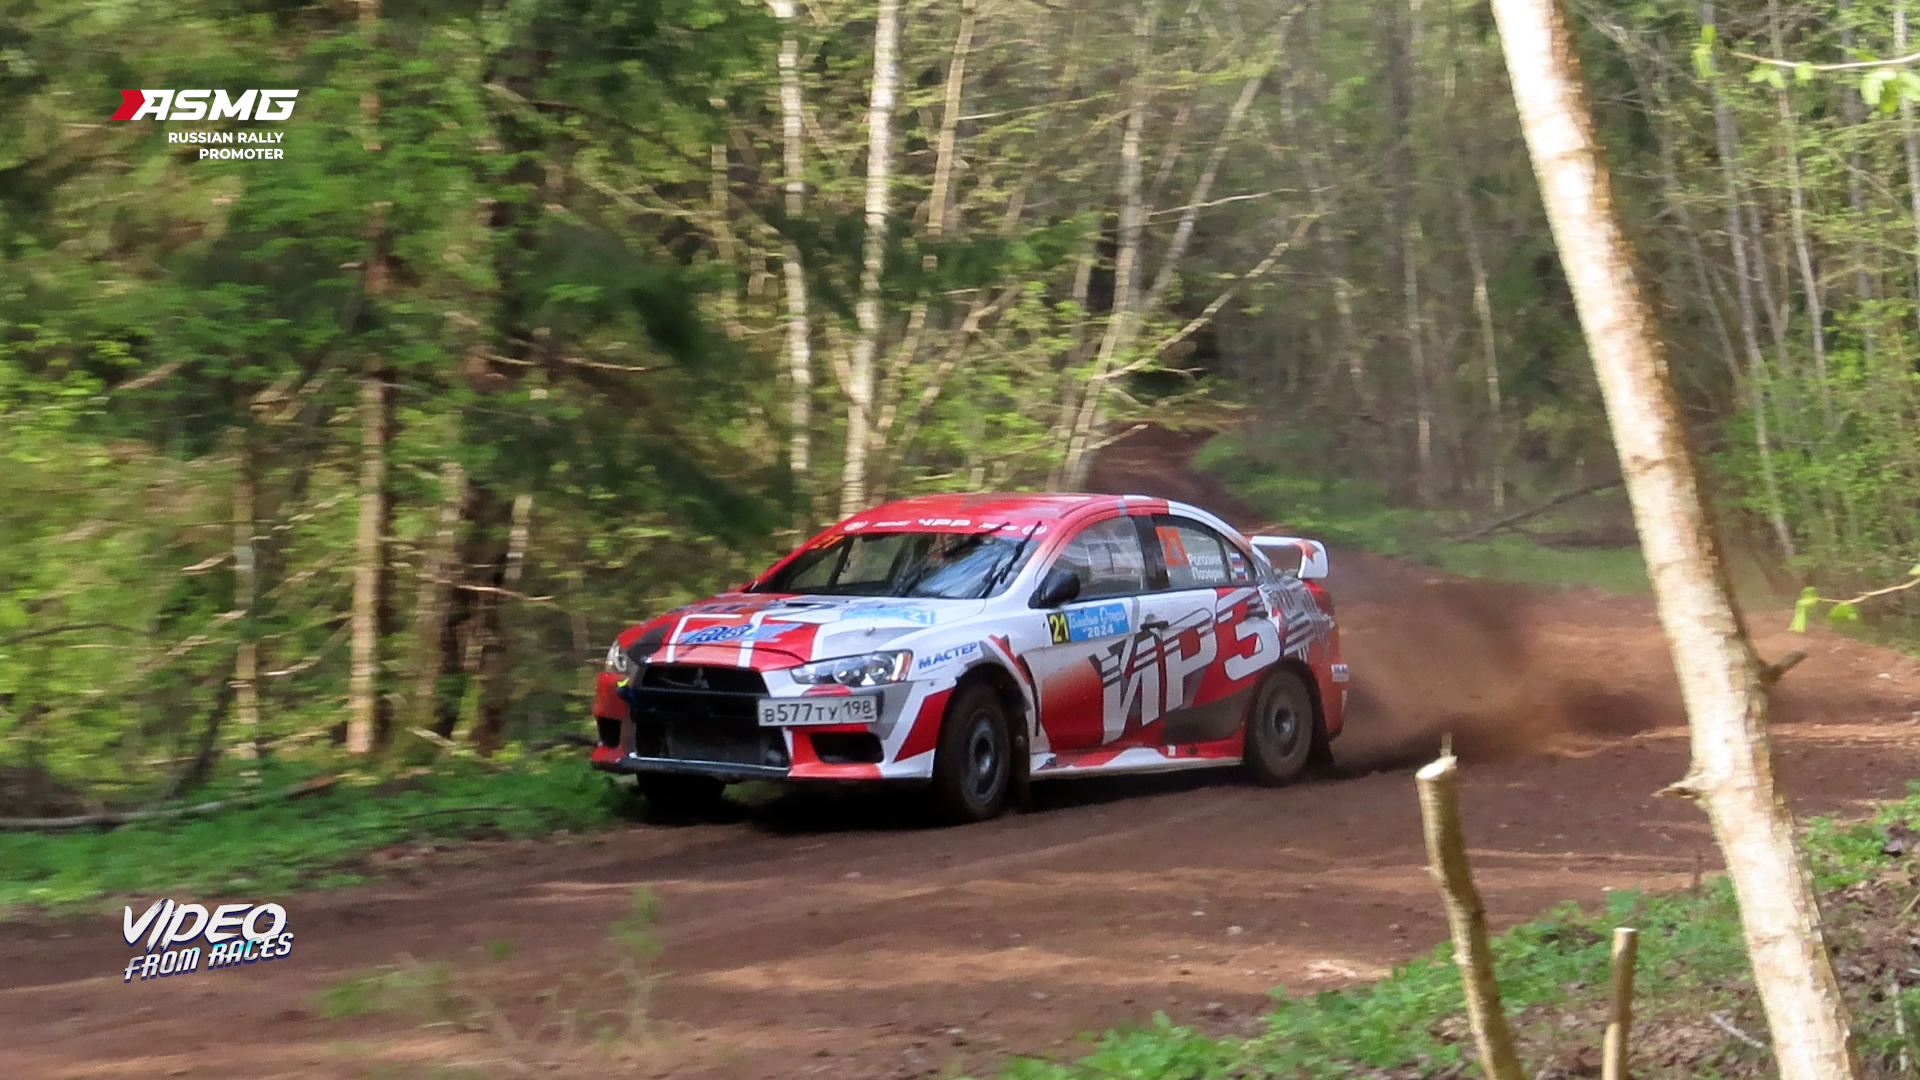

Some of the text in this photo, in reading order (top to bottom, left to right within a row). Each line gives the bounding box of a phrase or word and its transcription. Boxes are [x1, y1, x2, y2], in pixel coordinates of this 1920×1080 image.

[1049, 612, 1070, 643] 21
[1086, 623, 1115, 639] 2024
[918, 641, 978, 670] МАСТЕР
[763, 699, 873, 723] В577ТУ 198
